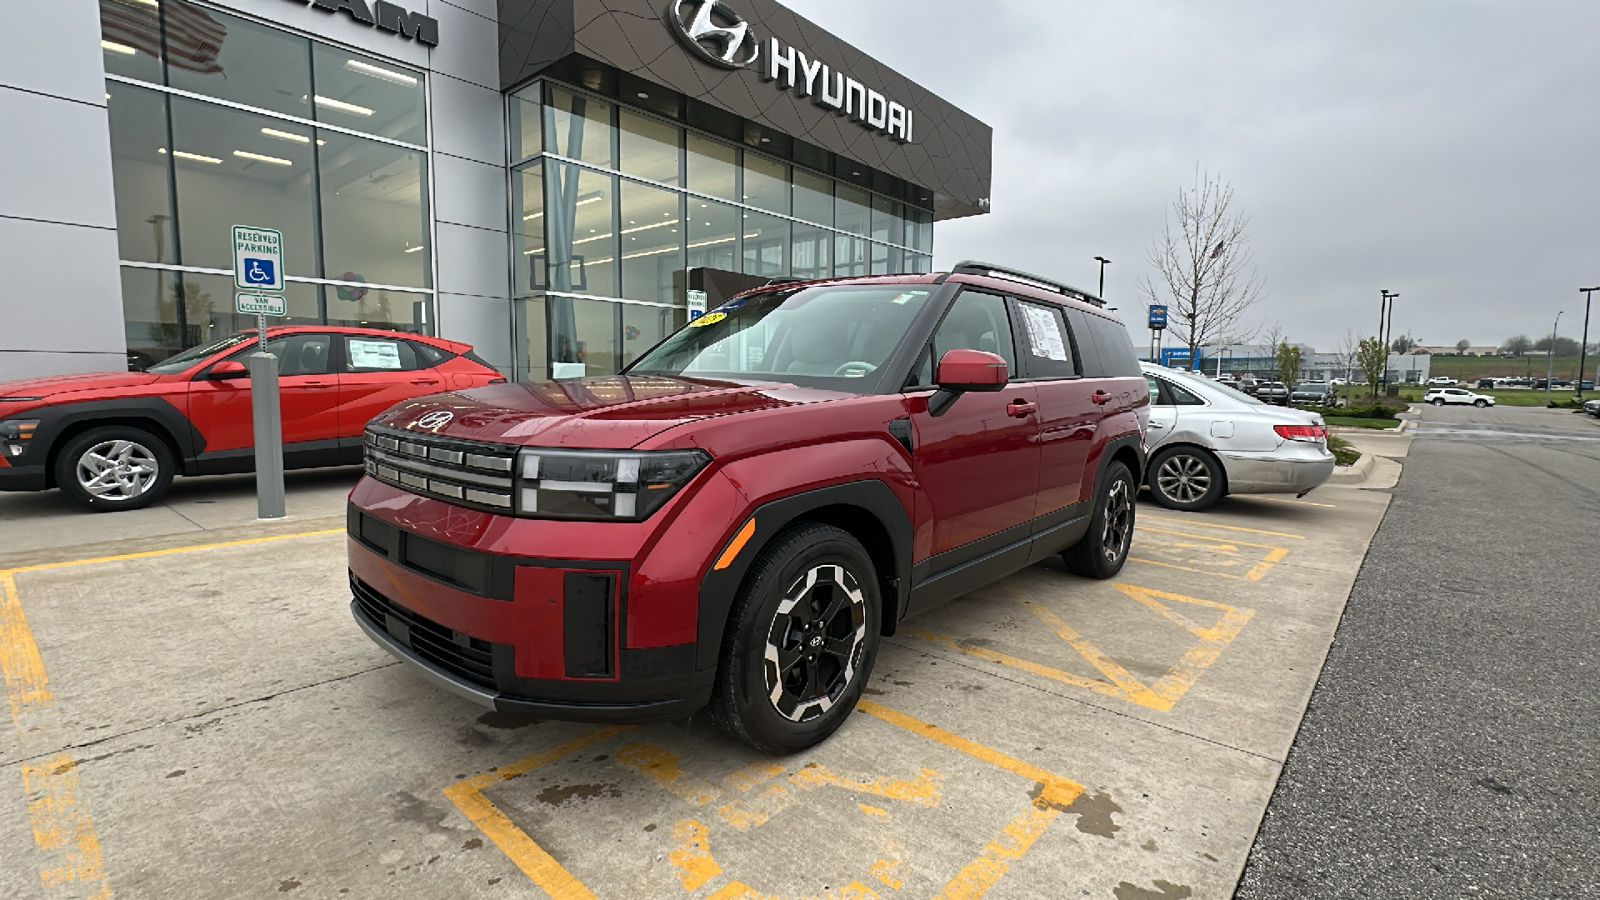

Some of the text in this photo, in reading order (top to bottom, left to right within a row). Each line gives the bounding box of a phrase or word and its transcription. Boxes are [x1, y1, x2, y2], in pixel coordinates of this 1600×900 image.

[288, 0, 438, 46] AM
[765, 36, 913, 143] HYUNDAI
[237, 231, 277, 244] RESERVED
[238, 243, 278, 254] PARKING
[241, 304, 282, 312] ACCESSIBLE
